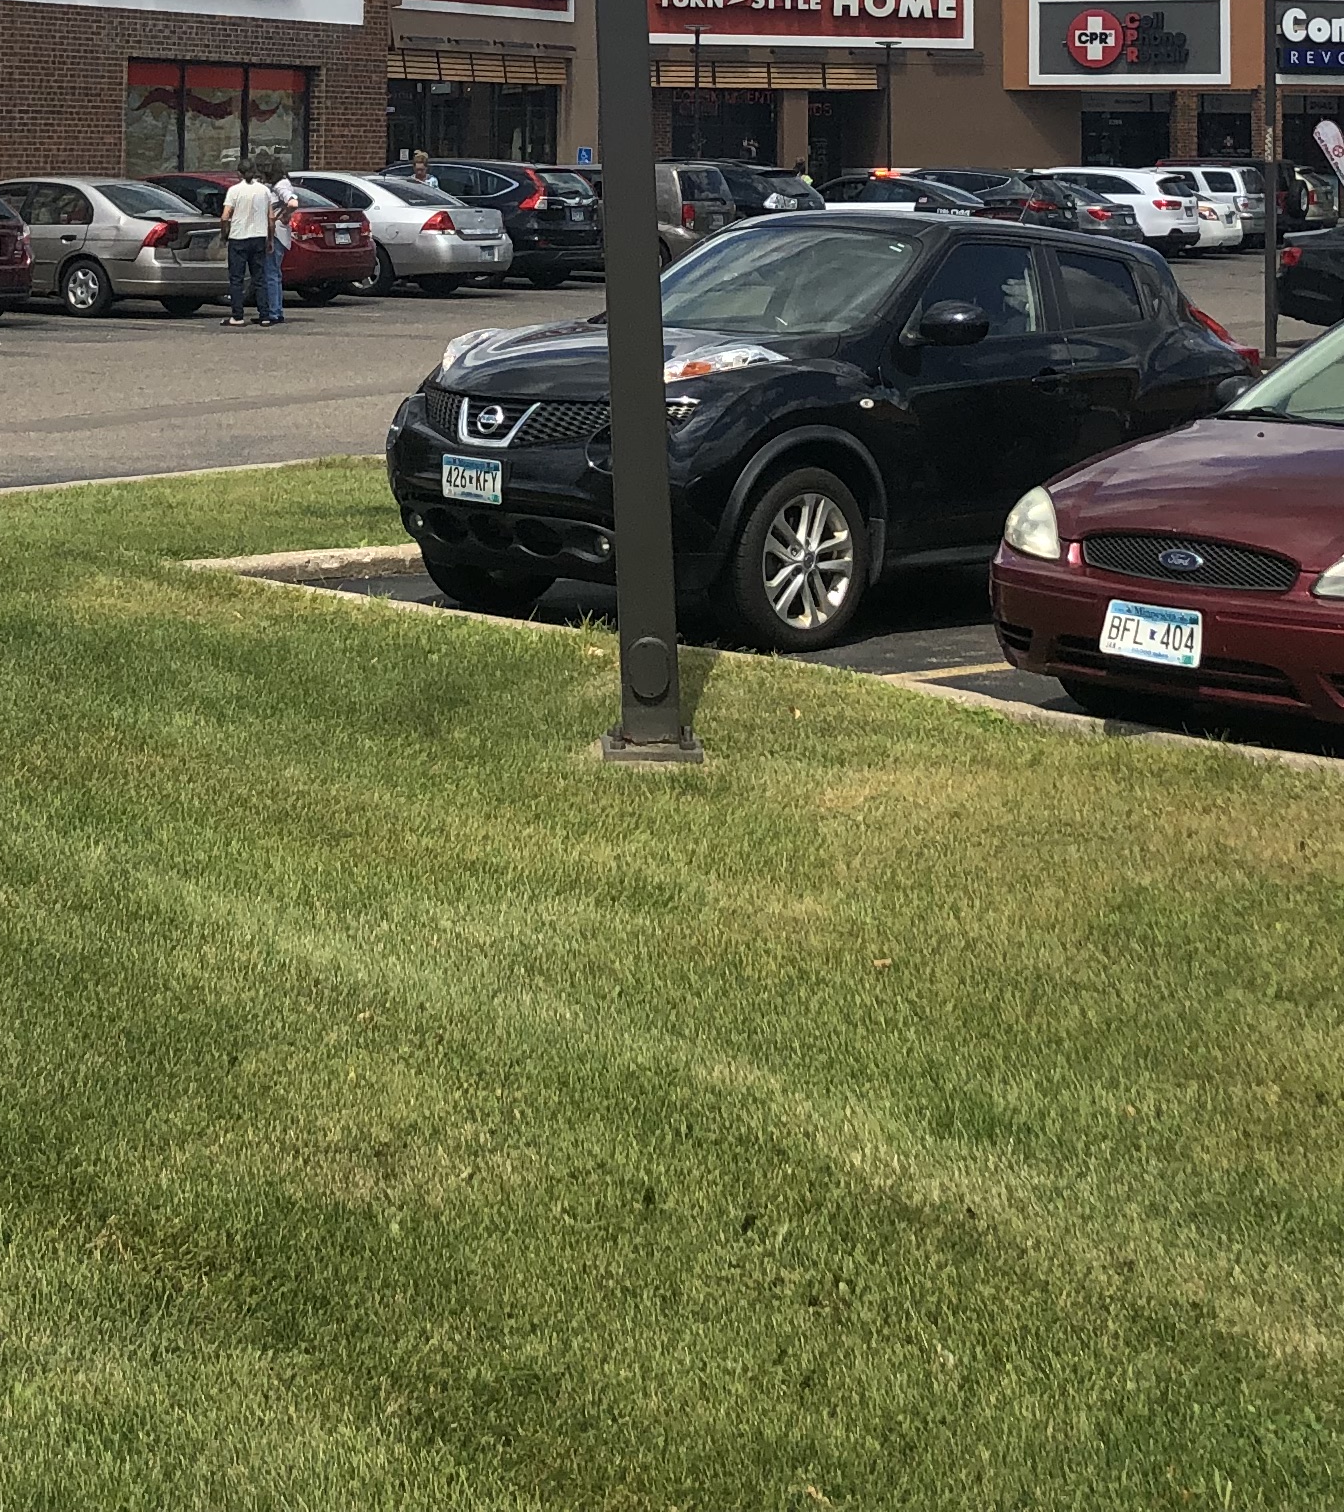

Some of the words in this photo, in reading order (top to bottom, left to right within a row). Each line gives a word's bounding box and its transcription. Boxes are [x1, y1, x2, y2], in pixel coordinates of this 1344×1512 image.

[1124, 11, 1164, 29] Cell
[446, 465, 467, 489] 426
[475, 469, 498, 493] KFY
[1107, 615, 1143, 646] BFL
[1160, 623, 1195, 653] 404
